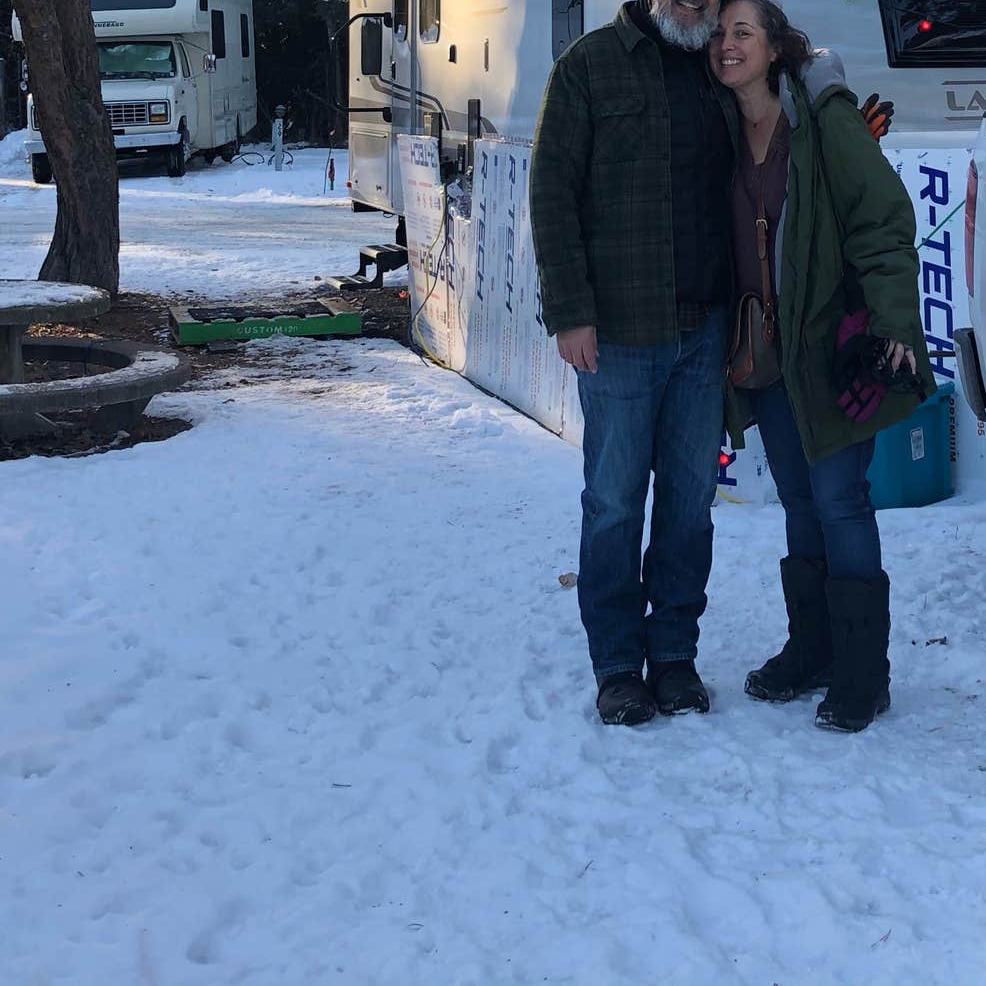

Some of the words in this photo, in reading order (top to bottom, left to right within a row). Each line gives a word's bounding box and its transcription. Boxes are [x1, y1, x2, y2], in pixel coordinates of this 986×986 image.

[477, 150, 488, 302] R-TECH
[506, 153, 516, 314] R-TECH
[919, 165, 955, 379] R-TECH
